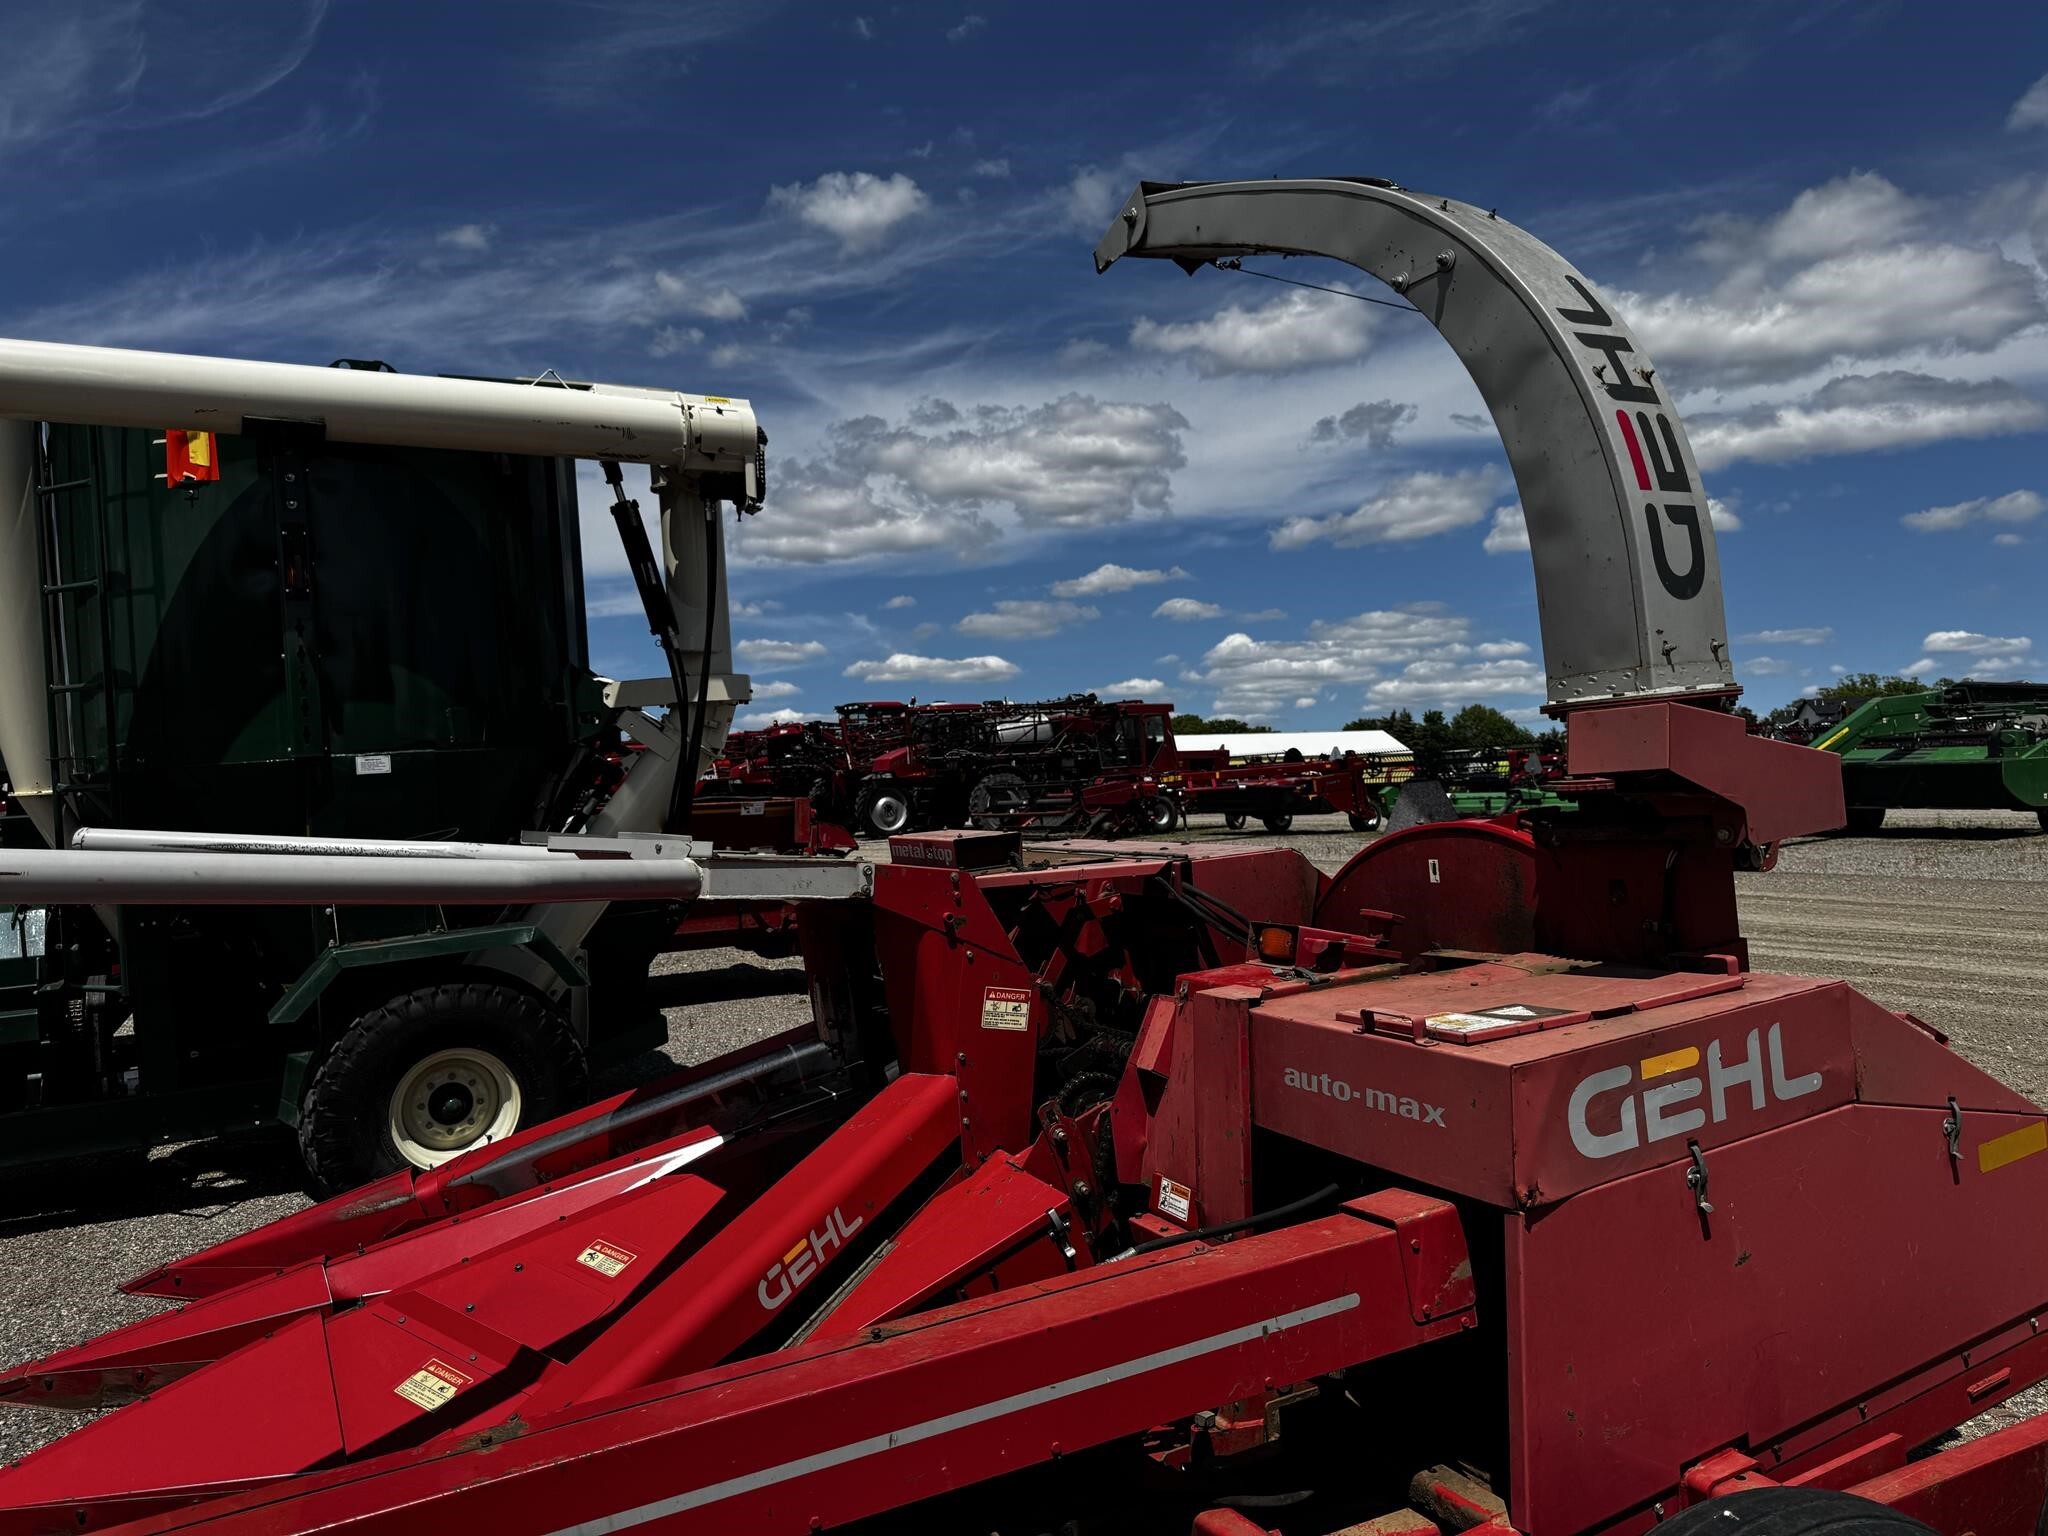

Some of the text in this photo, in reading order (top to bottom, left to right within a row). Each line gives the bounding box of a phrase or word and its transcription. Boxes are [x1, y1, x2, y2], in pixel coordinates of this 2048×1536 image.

[1555, 273, 1706, 600] GEHL
[996, 991, 1026, 1000] DANGER
[1283, 1066, 1447, 1129] auto-max
[1567, 1022, 1823, 1158] GEHL
[601, 1246, 630, 1262] DANGER
[757, 1206, 863, 1311] GEHL
[434, 1366, 464, 1386] DANGER
